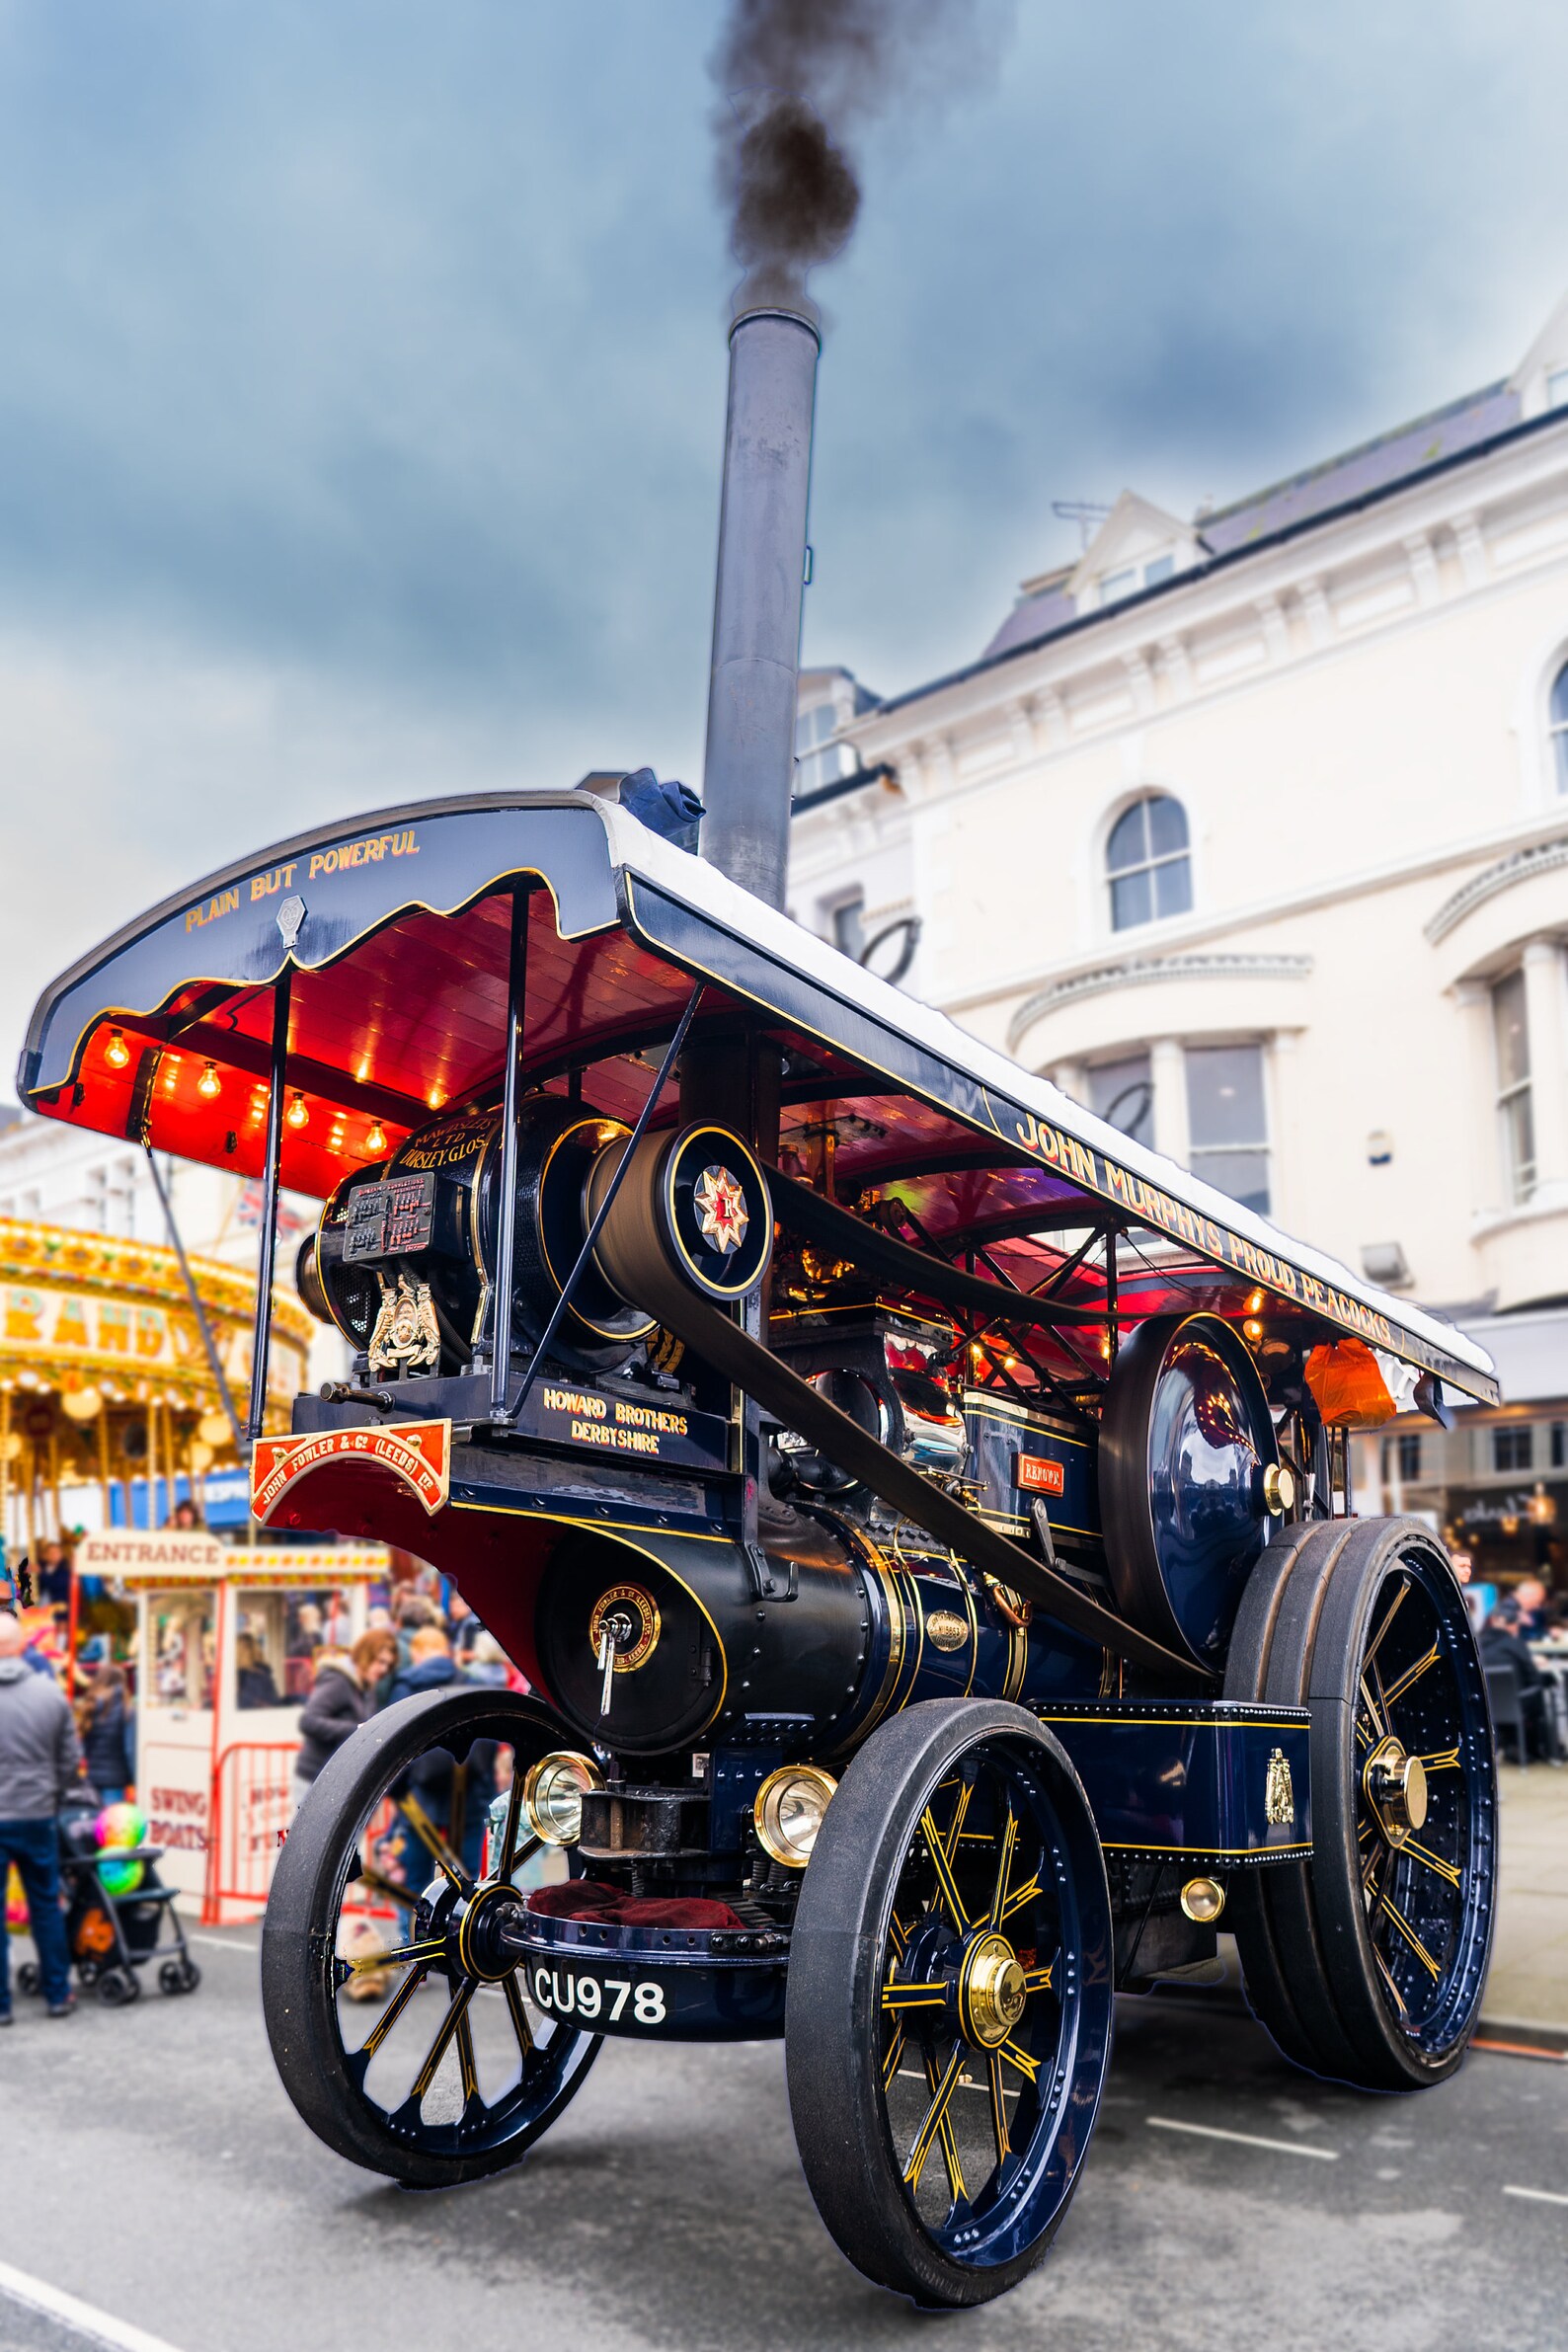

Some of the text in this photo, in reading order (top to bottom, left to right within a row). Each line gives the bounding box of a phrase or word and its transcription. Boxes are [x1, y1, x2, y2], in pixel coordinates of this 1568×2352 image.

[186, 830, 421, 933] PLAIN BUT POWERFUL
[431, 1132, 466, 1148] LTD
[723, 1198, 735, 1217] R
[1016, 1112, 1098, 1189] JOHN
[1104, 1159, 1223, 1258] MURPHYS
[1227, 1232, 1296, 1295] PROUD
[544, 1387, 688, 1436] HOWARD BROTHERS
[571, 1420, 660, 1454] DERBYSHIRE
[263, 1471, 287, 1505] JOHN
[291, 1438, 334, 1471] FOWLER
[340, 1436, 351, 1450] &
[375, 1440, 419, 1475] (LEEDS)
[86, 1542, 219, 1565] ENTRANCE
[597, 1591, 618, 1612] FOWLER
[151, 1787, 207, 1817] SWING
[150, 1820, 210, 1851] BOATS
[534, 1968, 666, 2024] CU978
